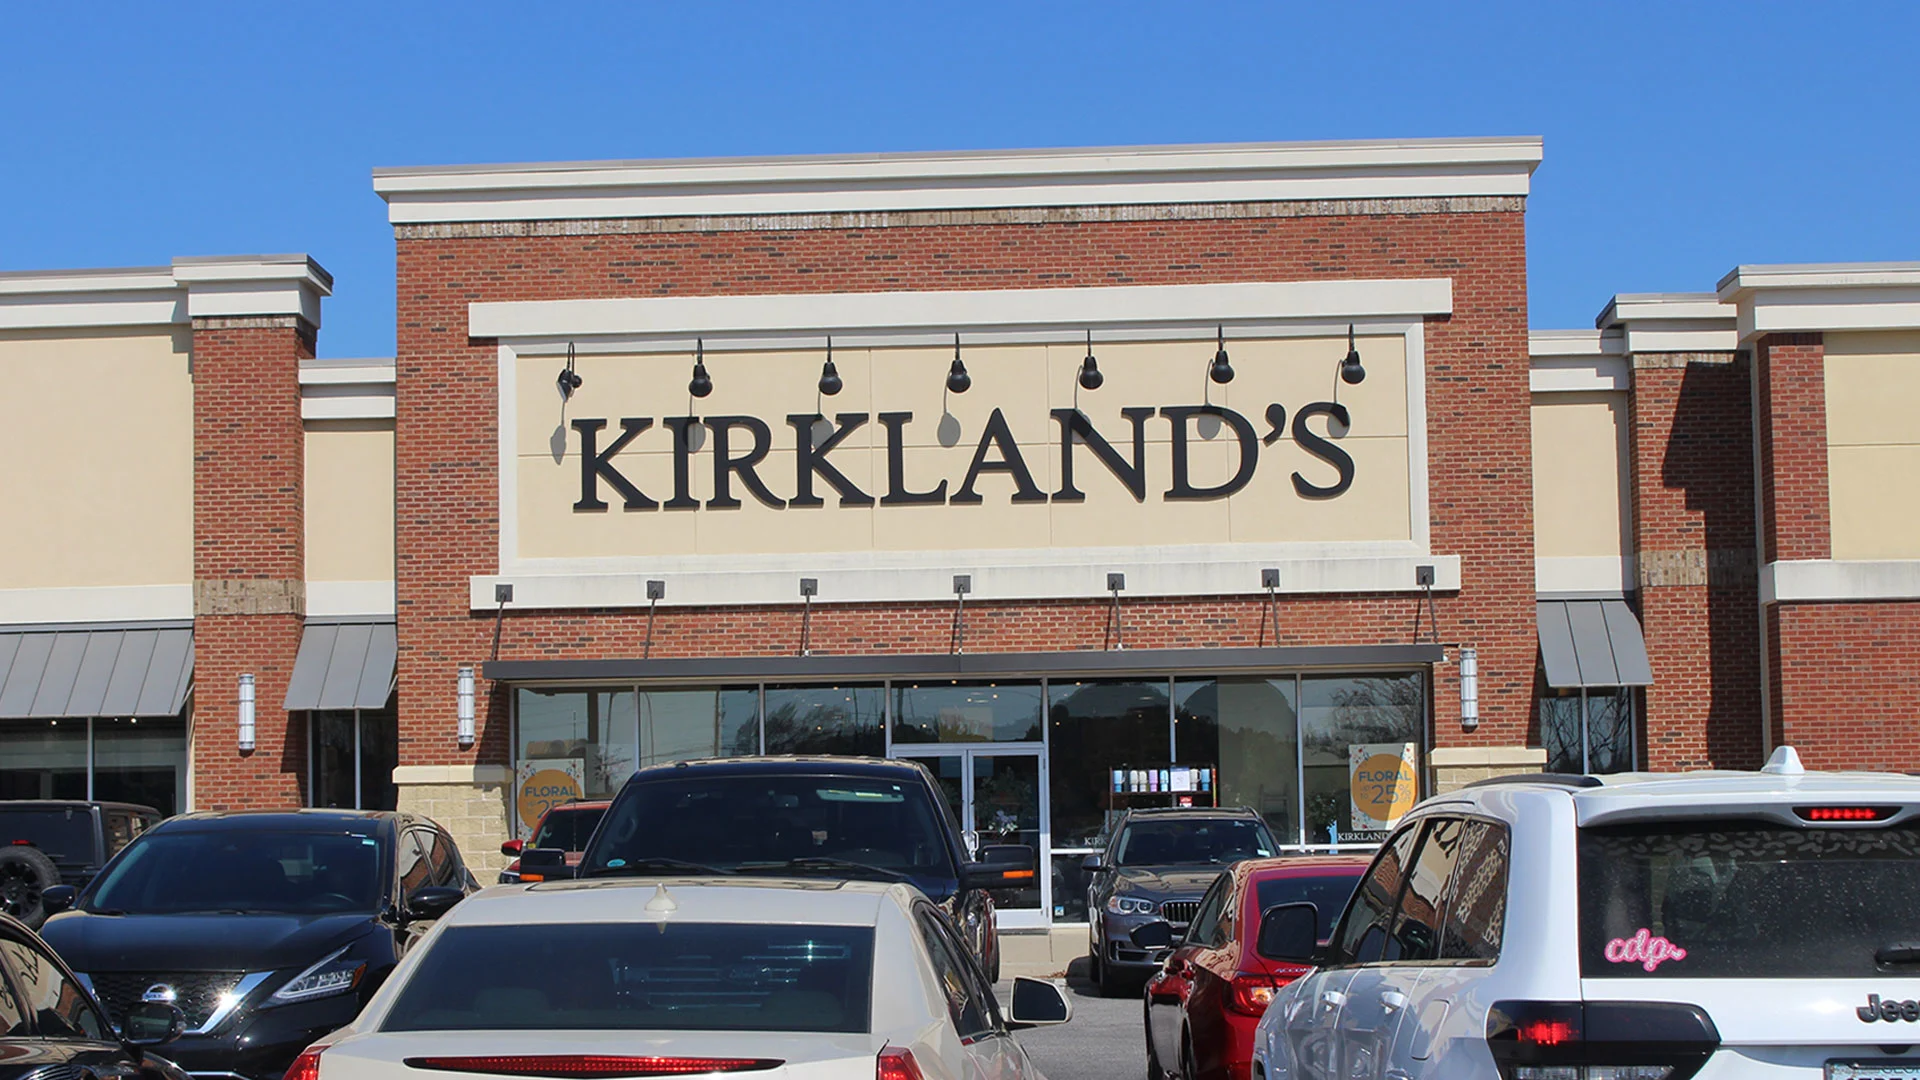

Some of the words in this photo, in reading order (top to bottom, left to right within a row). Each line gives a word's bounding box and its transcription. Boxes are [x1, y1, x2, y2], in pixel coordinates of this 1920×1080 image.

[571, 401, 1355, 512] KIRKLAND'S
[1358, 771, 1411, 782] FLORAL
[525, 786, 577, 797] FLORAL
[1856, 993, 1920, 1023] Jee
